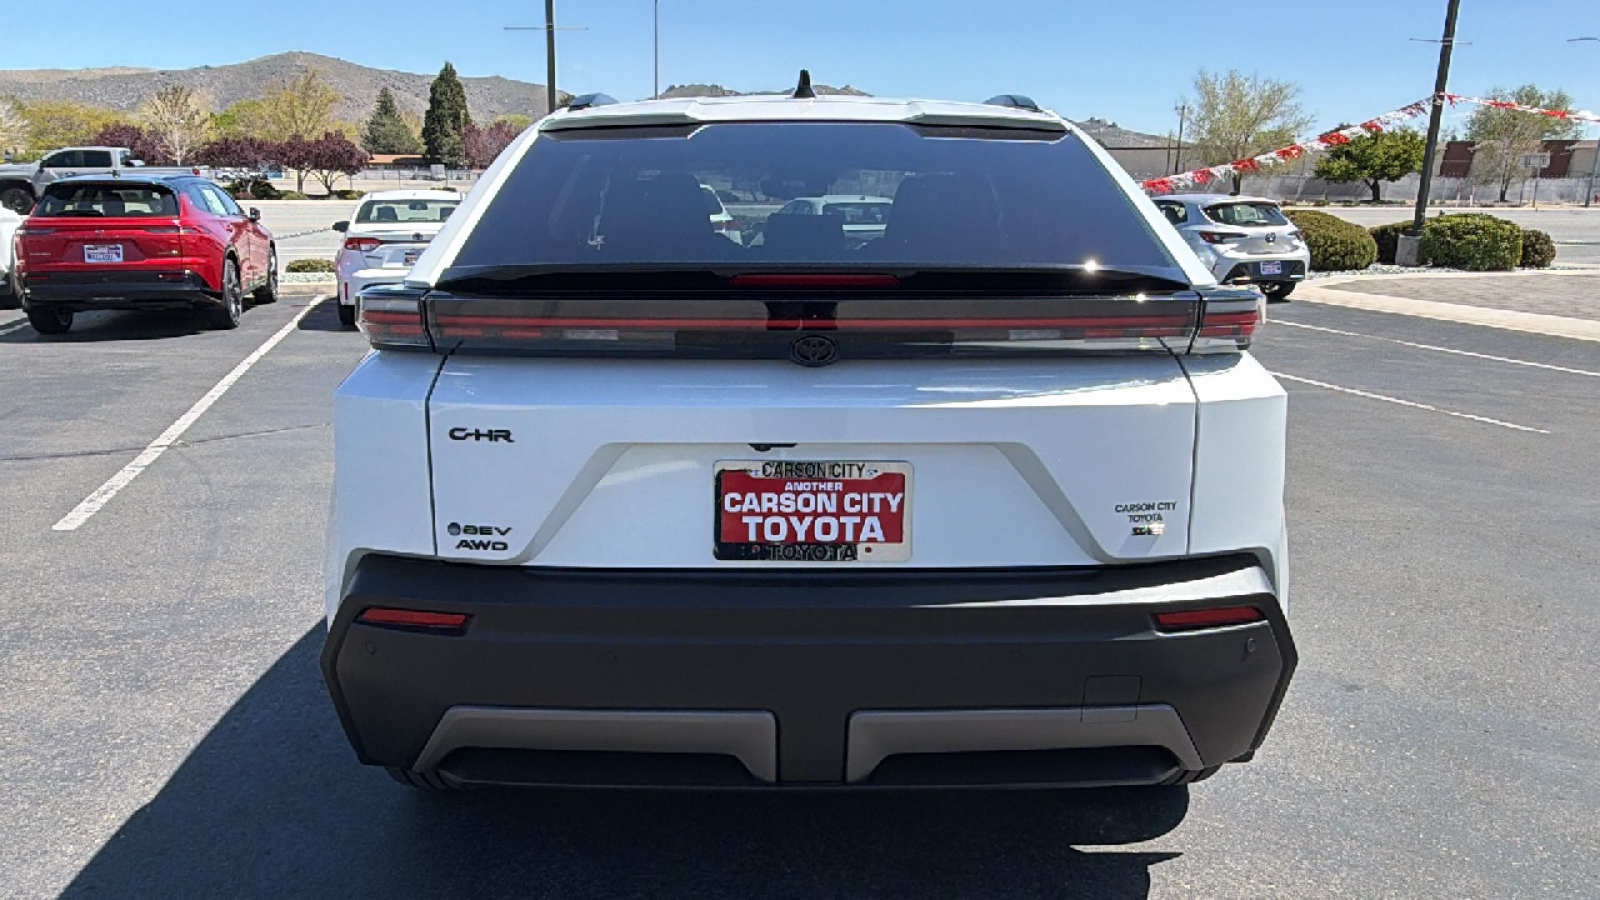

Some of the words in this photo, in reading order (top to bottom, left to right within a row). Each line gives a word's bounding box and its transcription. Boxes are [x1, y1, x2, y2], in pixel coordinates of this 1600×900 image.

[762, 462, 826, 478] CARSON
[832, 463, 866, 478] CITY
[785, 481, 843, 491] ANOTHER
[724, 492, 837, 513] CARSON
[843, 492, 904, 513] CITY
[1114, 502, 1156, 513] CARSON
[1157, 500, 1178, 511] CITY
[1128, 513, 1163, 523] TOYOTA
[462, 525, 513, 536] BEV
[742, 515, 886, 542] TOYOTA
[455, 539, 508, 551] AWD
[768, 544, 858, 561] TOYOTA
